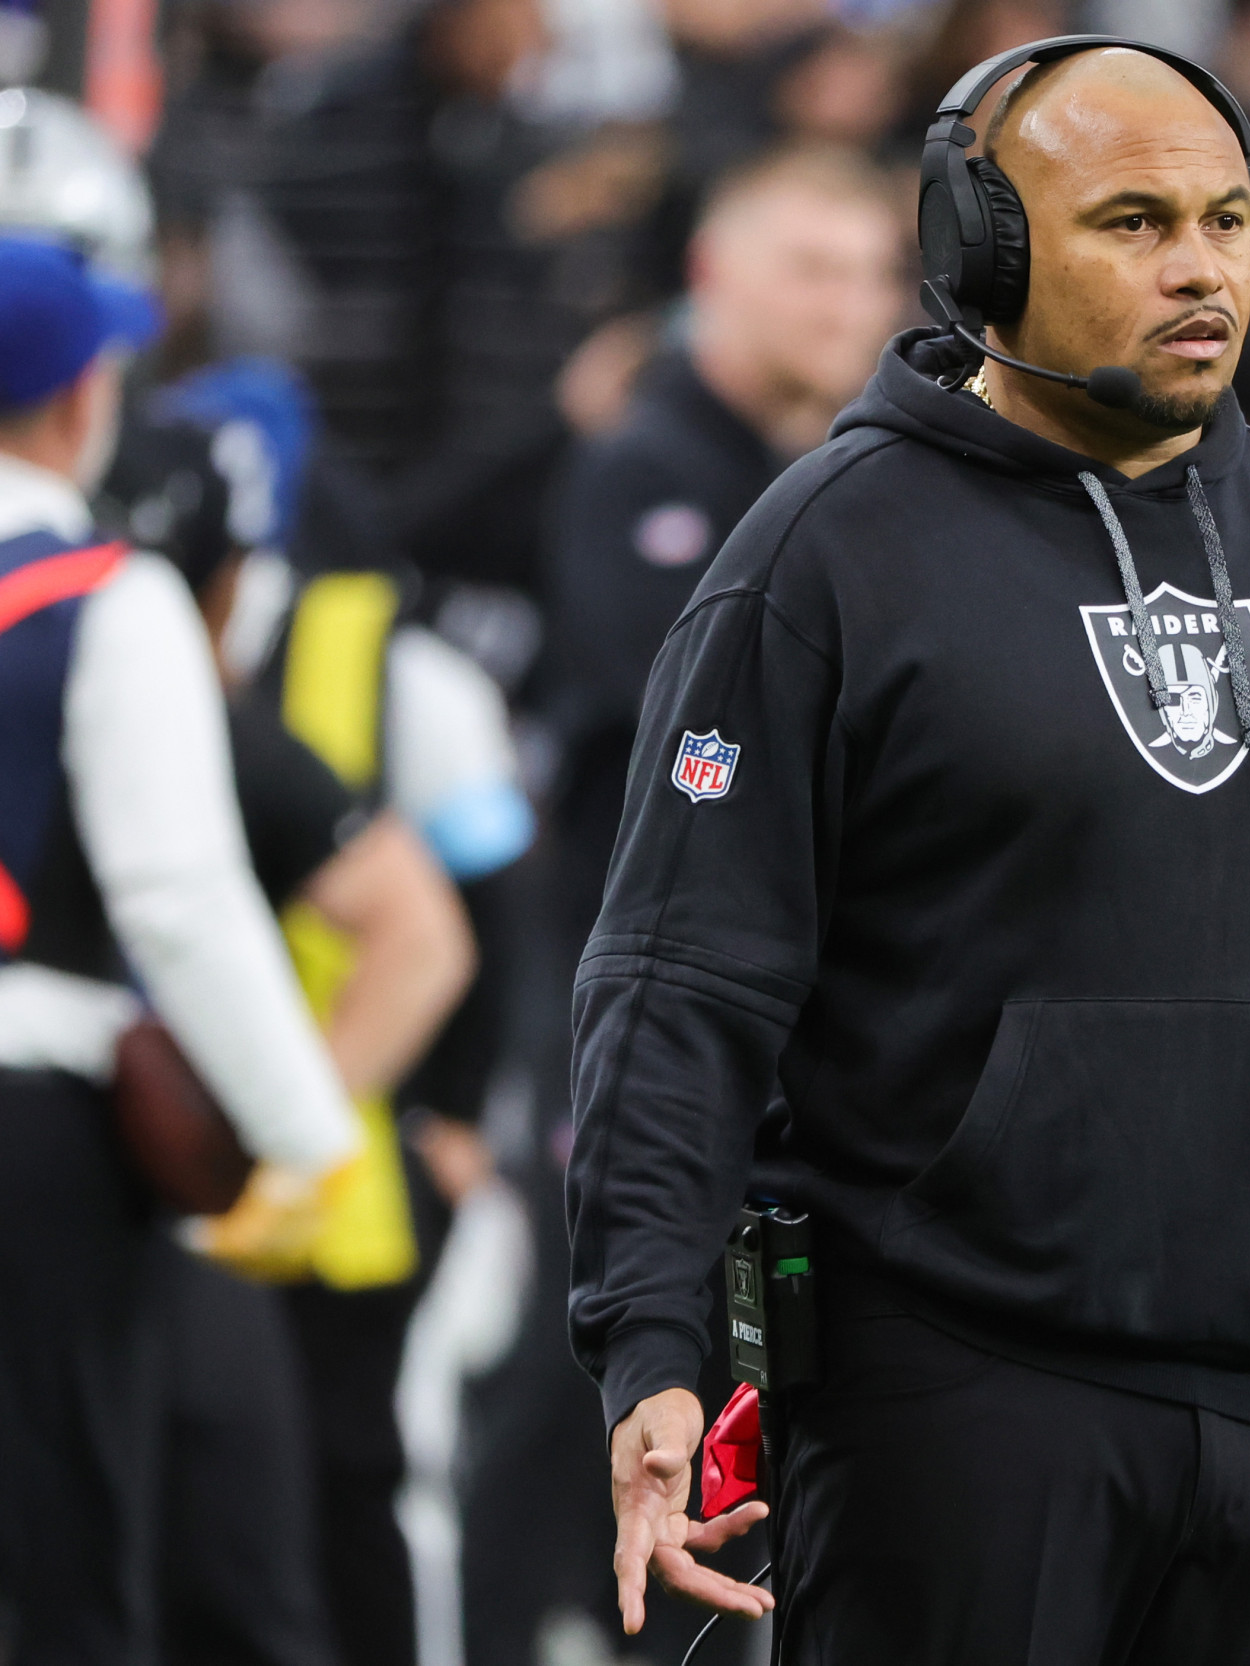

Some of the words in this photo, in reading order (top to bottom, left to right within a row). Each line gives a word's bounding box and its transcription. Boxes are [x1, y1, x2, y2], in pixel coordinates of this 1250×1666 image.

[1107, 612, 1236, 637] RIDER
[680, 757, 723, 790] NFL
[732, 1319, 738, 1338] A
[739, 1321, 763, 1346] PIERCE
